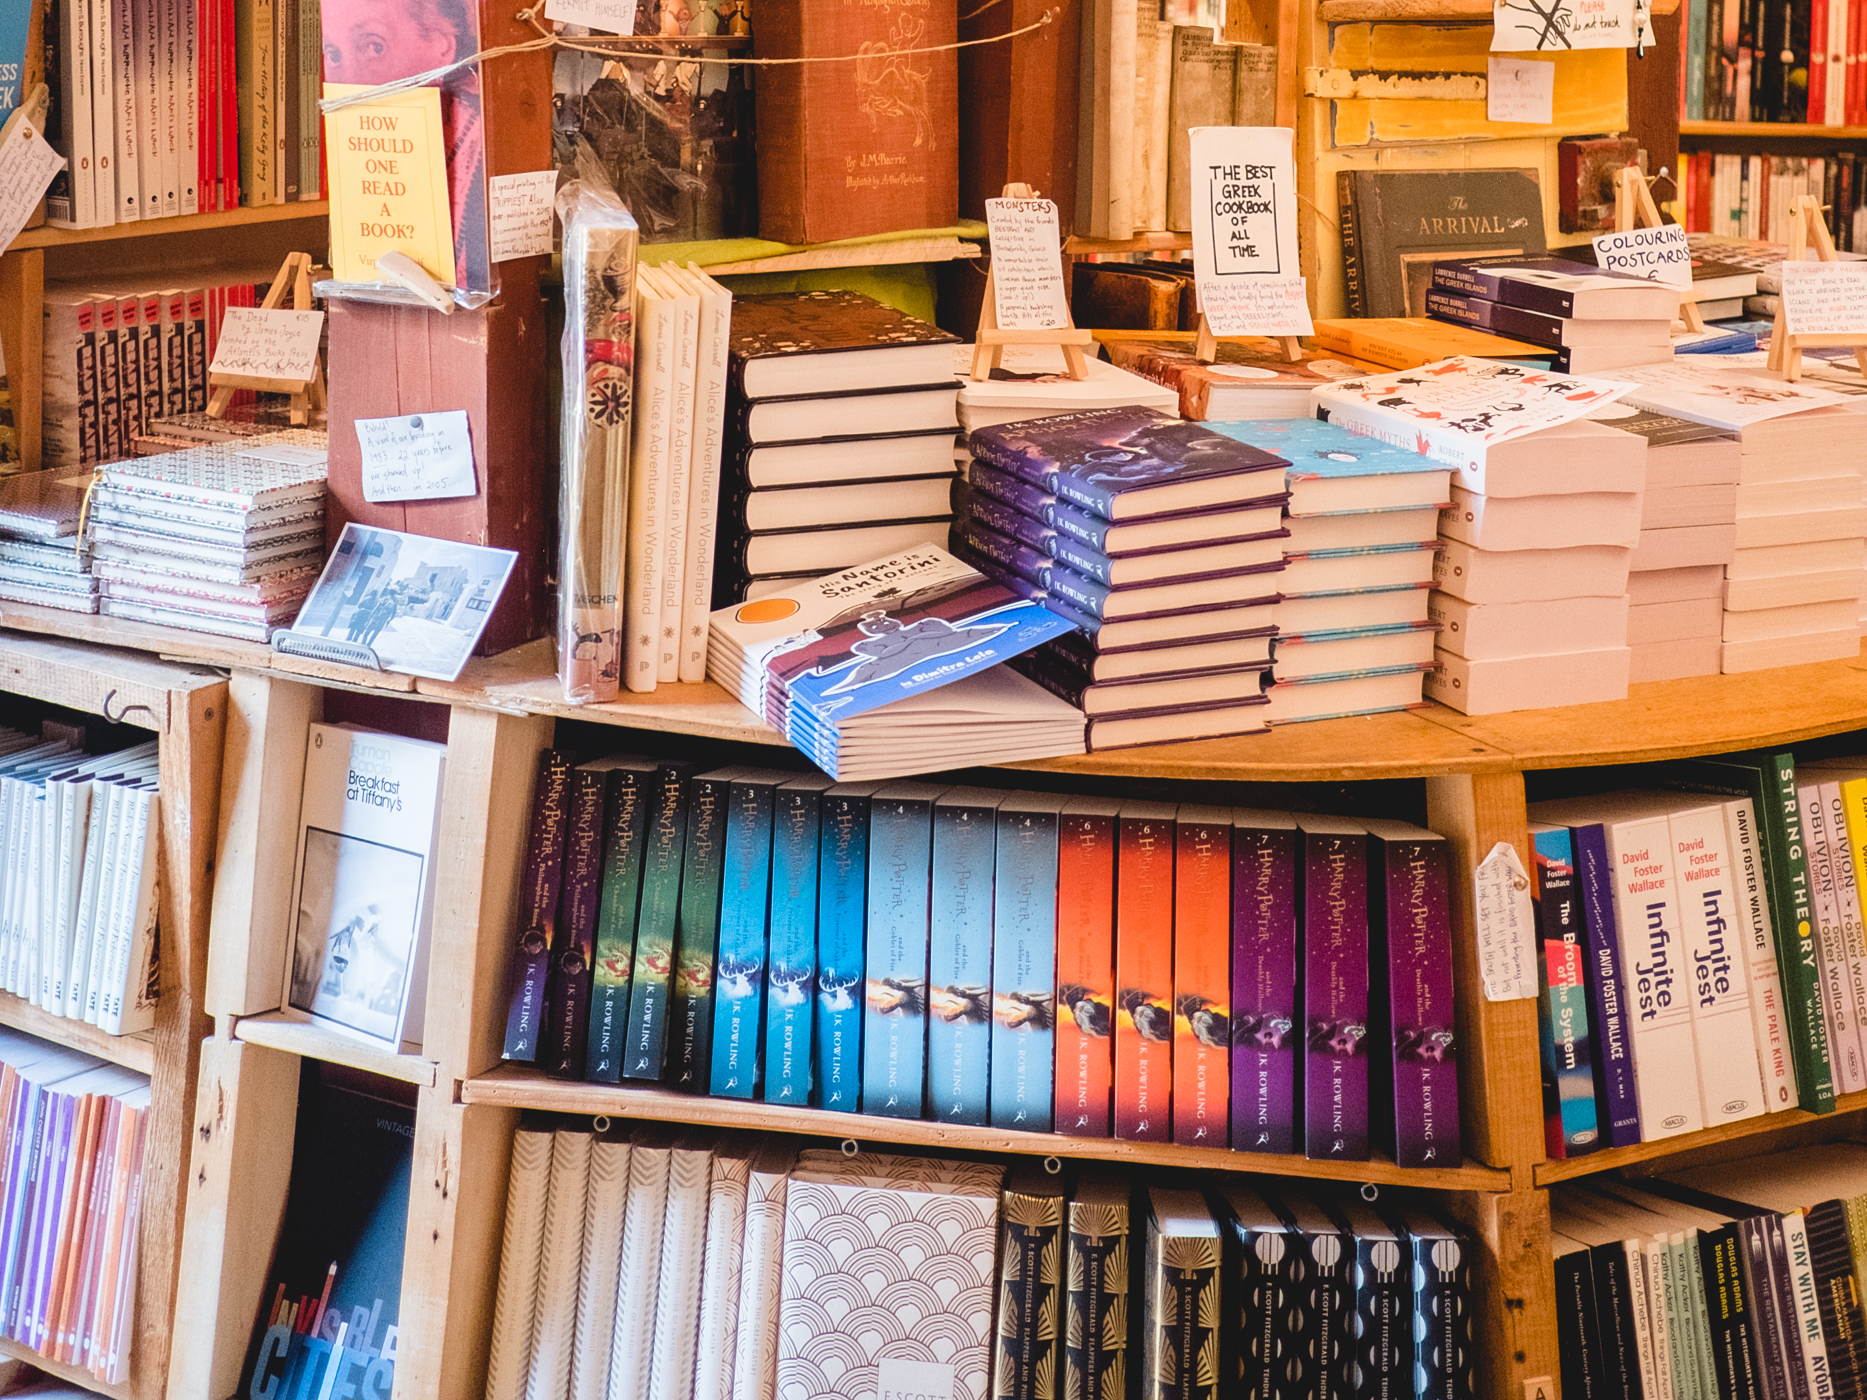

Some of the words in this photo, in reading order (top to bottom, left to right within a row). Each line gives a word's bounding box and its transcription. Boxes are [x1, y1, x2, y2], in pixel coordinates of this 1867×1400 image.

[595, 2, 633, 18] HIMSELF!
[1579, 0, 1605, 12] PLEASE
[1600, 16, 1621, 29] touch
[359, 115, 398, 130] HOW
[348, 136, 413, 154] SHOULD
[365, 159, 398, 175] ONE
[1209, 165, 1240, 181] THE
[1245, 165, 1275, 180] BEST
[361, 180, 405, 196] READ
[1222, 183, 1261, 199] GREEK
[380, 203, 391, 217] A
[994, 200, 1052, 214] MONSTERS
[1214, 201, 1272, 216] COOKBOOK
[1447, 195, 1468, 212] The
[360, 223, 414, 239] BOOK?
[1231, 216, 1248, 227] OF
[1418, 215, 1505, 236] ARRIVAL
[1230, 229, 1250, 241] ALL
[1597, 228, 1685, 254] COLOURING
[1229, 245, 1259, 258] TIME
[1606, 244, 1690, 269] POSTCARDS
[1435, 277, 1444, 285] THE
[1446, 279, 1464, 289] GREEK
[1464, 283, 1487, 294] ISLANDS
[246, 312, 269, 323] Dead
[296, 314, 310, 323] €15
[1040, 319, 1055, 327] €20
[255, 325, 278, 338] James
[281, 327, 301, 339] Joyce
[711, 336, 723, 367] Carroll
[707, 381, 720, 423] Alice's
[1346, 420, 1376, 439] GREEK
[1379, 430, 1411, 450] MYTHS
[370, 450, 387, 464] 1983
[398, 450, 409, 461] 22
[412, 448, 430, 465] years
[432, 441, 453, 455] before
[1438, 444, 1465, 461] ROBERT
[702, 430, 716, 504] Adventures
[694, 522, 709, 605] Wonderland
[842, 559, 901, 581] Name
[822, 555, 941, 601] Santorini
[912, 660, 964, 684] Dimitra
[964, 648, 995, 665] Lola
[348, 770, 399, 792] Breakfast
[547, 765, 566, 812] HARRY
[346, 787, 358, 800] at
[360, 786, 403, 813] Tiffany's
[1780, 768, 1802, 860] STRING
[1809, 801, 1833, 902] OBLIVION:
[1258, 848, 1272, 895] HARRY
[1491, 861, 1502, 881] with
[1546, 859, 1565, 868] David
[1547, 869, 1567, 878] Foster
[1479, 884, 1490, 903] YOU
[1545, 878, 1570, 889] Wallace
[1492, 883, 1506, 914] finished
[1256, 894, 1273, 942] POTTER
[1481, 907, 1490, 921] SET
[1510, 906, 1518, 927] DAVID
[1560, 901, 1570, 924] The
[1499, 937, 1509, 957] until
[1645, 902, 1673, 1009] Infinite
[1485, 951, 1495, 977] TRUTH
[1511, 946, 1523, 980] Presenting
[1563, 933, 1578, 990] Broom
[1598, 948, 1610, 979] DAVID
[1602, 978, 1617, 1016] FOSTER
[1635, 961, 1657, 1021] Jest
[1764, 988, 1774, 1010] THE
[111, 998, 120, 1017] TATE
[601, 1001, 614, 1053] ROWLING
[1561, 1008, 1575, 1069] System
[1608, 1014, 1624, 1059] WALLACE
[1768, 1014, 1779, 1043] PALE
[833, 1029, 842, 1083] ROWLING
[1772, 1048, 1784, 1077] KING
[1078, 1050, 1088, 1108] ROWLING
[1819, 1091, 1832, 1099] LOA
[1422, 1082, 1433, 1141] ROWLING
[1614, 1118, 1637, 1128] GRANTA
[1791, 1232, 1808, 1266] STAY
[1631, 1250, 1642, 1289] Chinua
[1726, 1237, 1739, 1281] DOUGLAS
[1733, 1278, 1743, 1313] ADAMS
[1798, 1271, 1815, 1317] WITH
[1636, 1289, 1647, 1331] Achebe
[1806, 1318, 1821, 1343] ME
